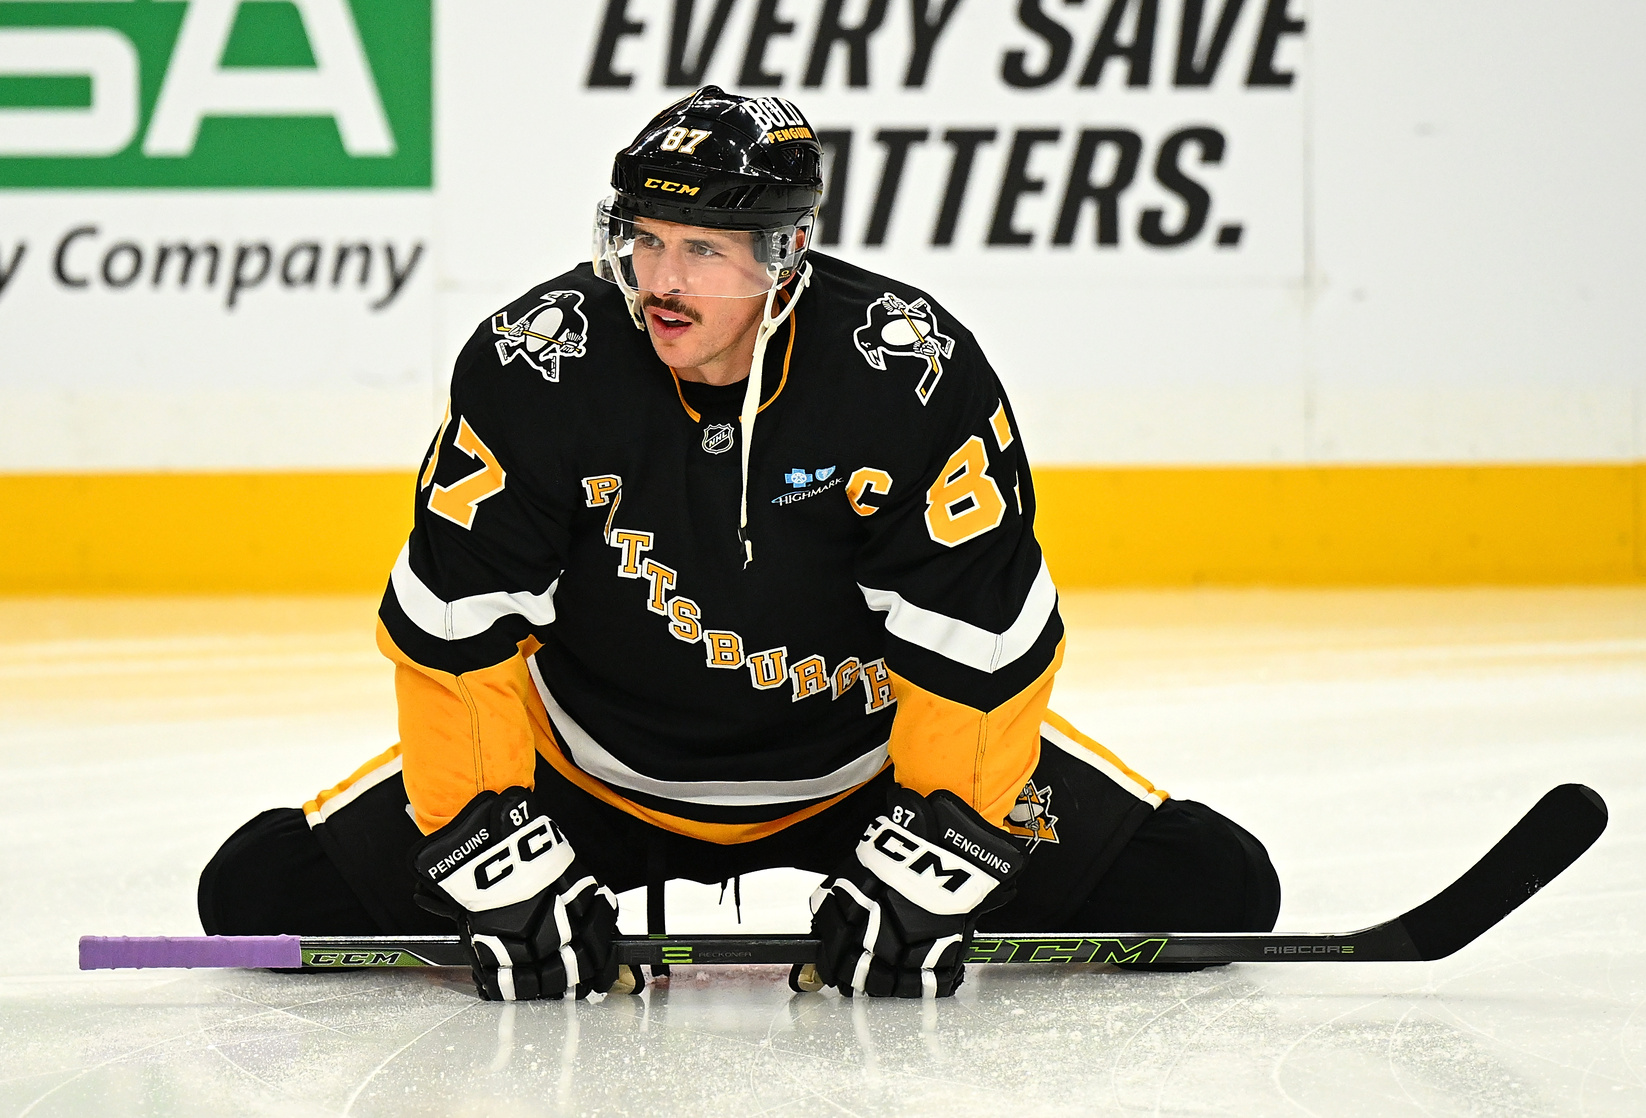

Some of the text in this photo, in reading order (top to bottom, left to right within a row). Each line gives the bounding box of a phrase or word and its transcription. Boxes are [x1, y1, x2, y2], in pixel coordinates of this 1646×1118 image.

[585, 0, 1306, 88] EVERY SAVE
[740, 96, 804, 131] BOLD
[660, 126, 713, 155] 87
[644, 177, 700, 197] CCM
[814, 127, 1244, 248] ATTERS.
[52, 223, 425, 313] Company
[708, 430, 729, 449] NHL
[421, 399, 507, 531] 7
[778, 477, 844, 507] HIGHMARK
[845, 466, 893, 517] C
[509, 801, 530, 827] 87
[892, 805, 916, 828] 87
[427, 828, 490, 880] PENGUINS
[473, 820, 564, 890] CC
[943, 828, 1012, 875] PENGUINS
[309, 951, 402, 966] CCM
